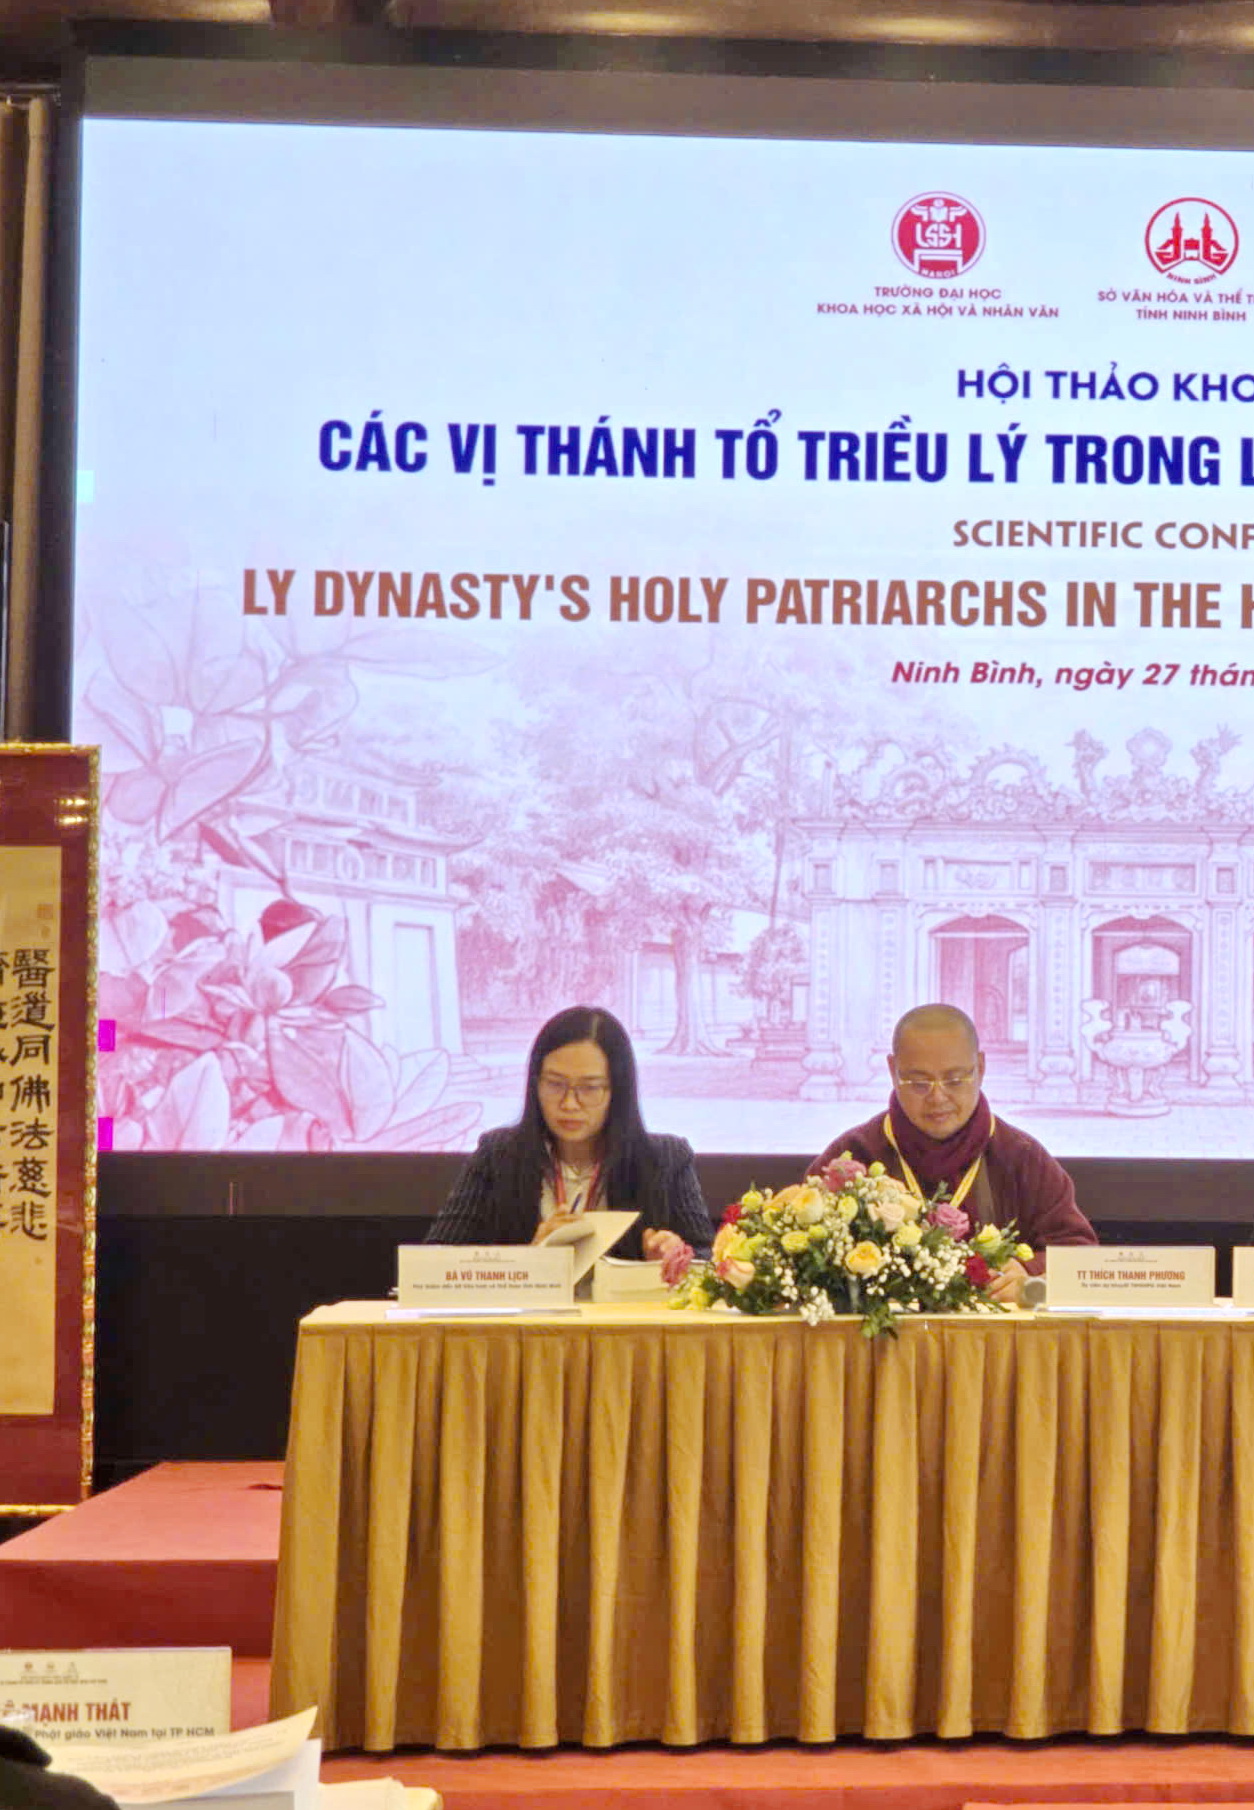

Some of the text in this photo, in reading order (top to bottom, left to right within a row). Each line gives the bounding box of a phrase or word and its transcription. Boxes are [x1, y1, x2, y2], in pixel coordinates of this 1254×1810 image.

[874, 284, 1002, 302] TRƯỜNG ĐẠI HỌC
[1097, 287, 1118, 302] SỞ
[1121, 288, 1153, 303] VĂN
[1156, 288, 1189, 303] HÓA
[1193, 289, 1214, 304] VÀ
[1217, 288, 1243, 305] THỂ
[816, 302, 1060, 318] KHOA HỌC XÃ HỘI VÀ NHÂN VĂN
[1135, 306, 1247, 322] TỈNH NINH BÌNH
[957, 362, 1031, 404] HỘI
[1044, 361, 1160, 401] THẢO
[318, 409, 428, 474] CÁC
[447, 422, 497, 487] VỊ
[516, 415, 696, 479] THÁNH
[714, 408, 782, 481] TỔ
[797, 414, 948, 483] TRIỀU
[968, 422, 1028, 484] LÝ
[1044, 433, 1221, 486] TRONG
[953, 519, 1143, 549] SCIENTIFIC
[242, 568, 297, 617] LY
[313, 569, 591, 623] DYNASTY'S
[609, 575, 729, 625] HOLY
[746, 577, 1048, 628] PATRIARCHS
[1066, 581, 1117, 628] IN
[1133, 581, 1222, 629] THE
[891, 660, 961, 684] Ninh
[969, 659, 1043, 689] Bình,
[1054, 660, 1135, 692] ngày
[1141, 662, 1181, 686] 27
[476, 1271, 505, 1281] THANH
[1077, 1270, 1087, 1280] TT
[1090, 1268, 1115, 1280] THÍCH
[1118, 1270, 1147, 1280] THANH
[65, 1727, 90, 1741] giáo
[95, 1727, 117, 1740] Việt
[121, 1728, 148, 1738] Nam
[152, 1727, 166, 1739] tại
[170, 1727, 183, 1737] TP
[186, 1726, 215, 1737] HCM
